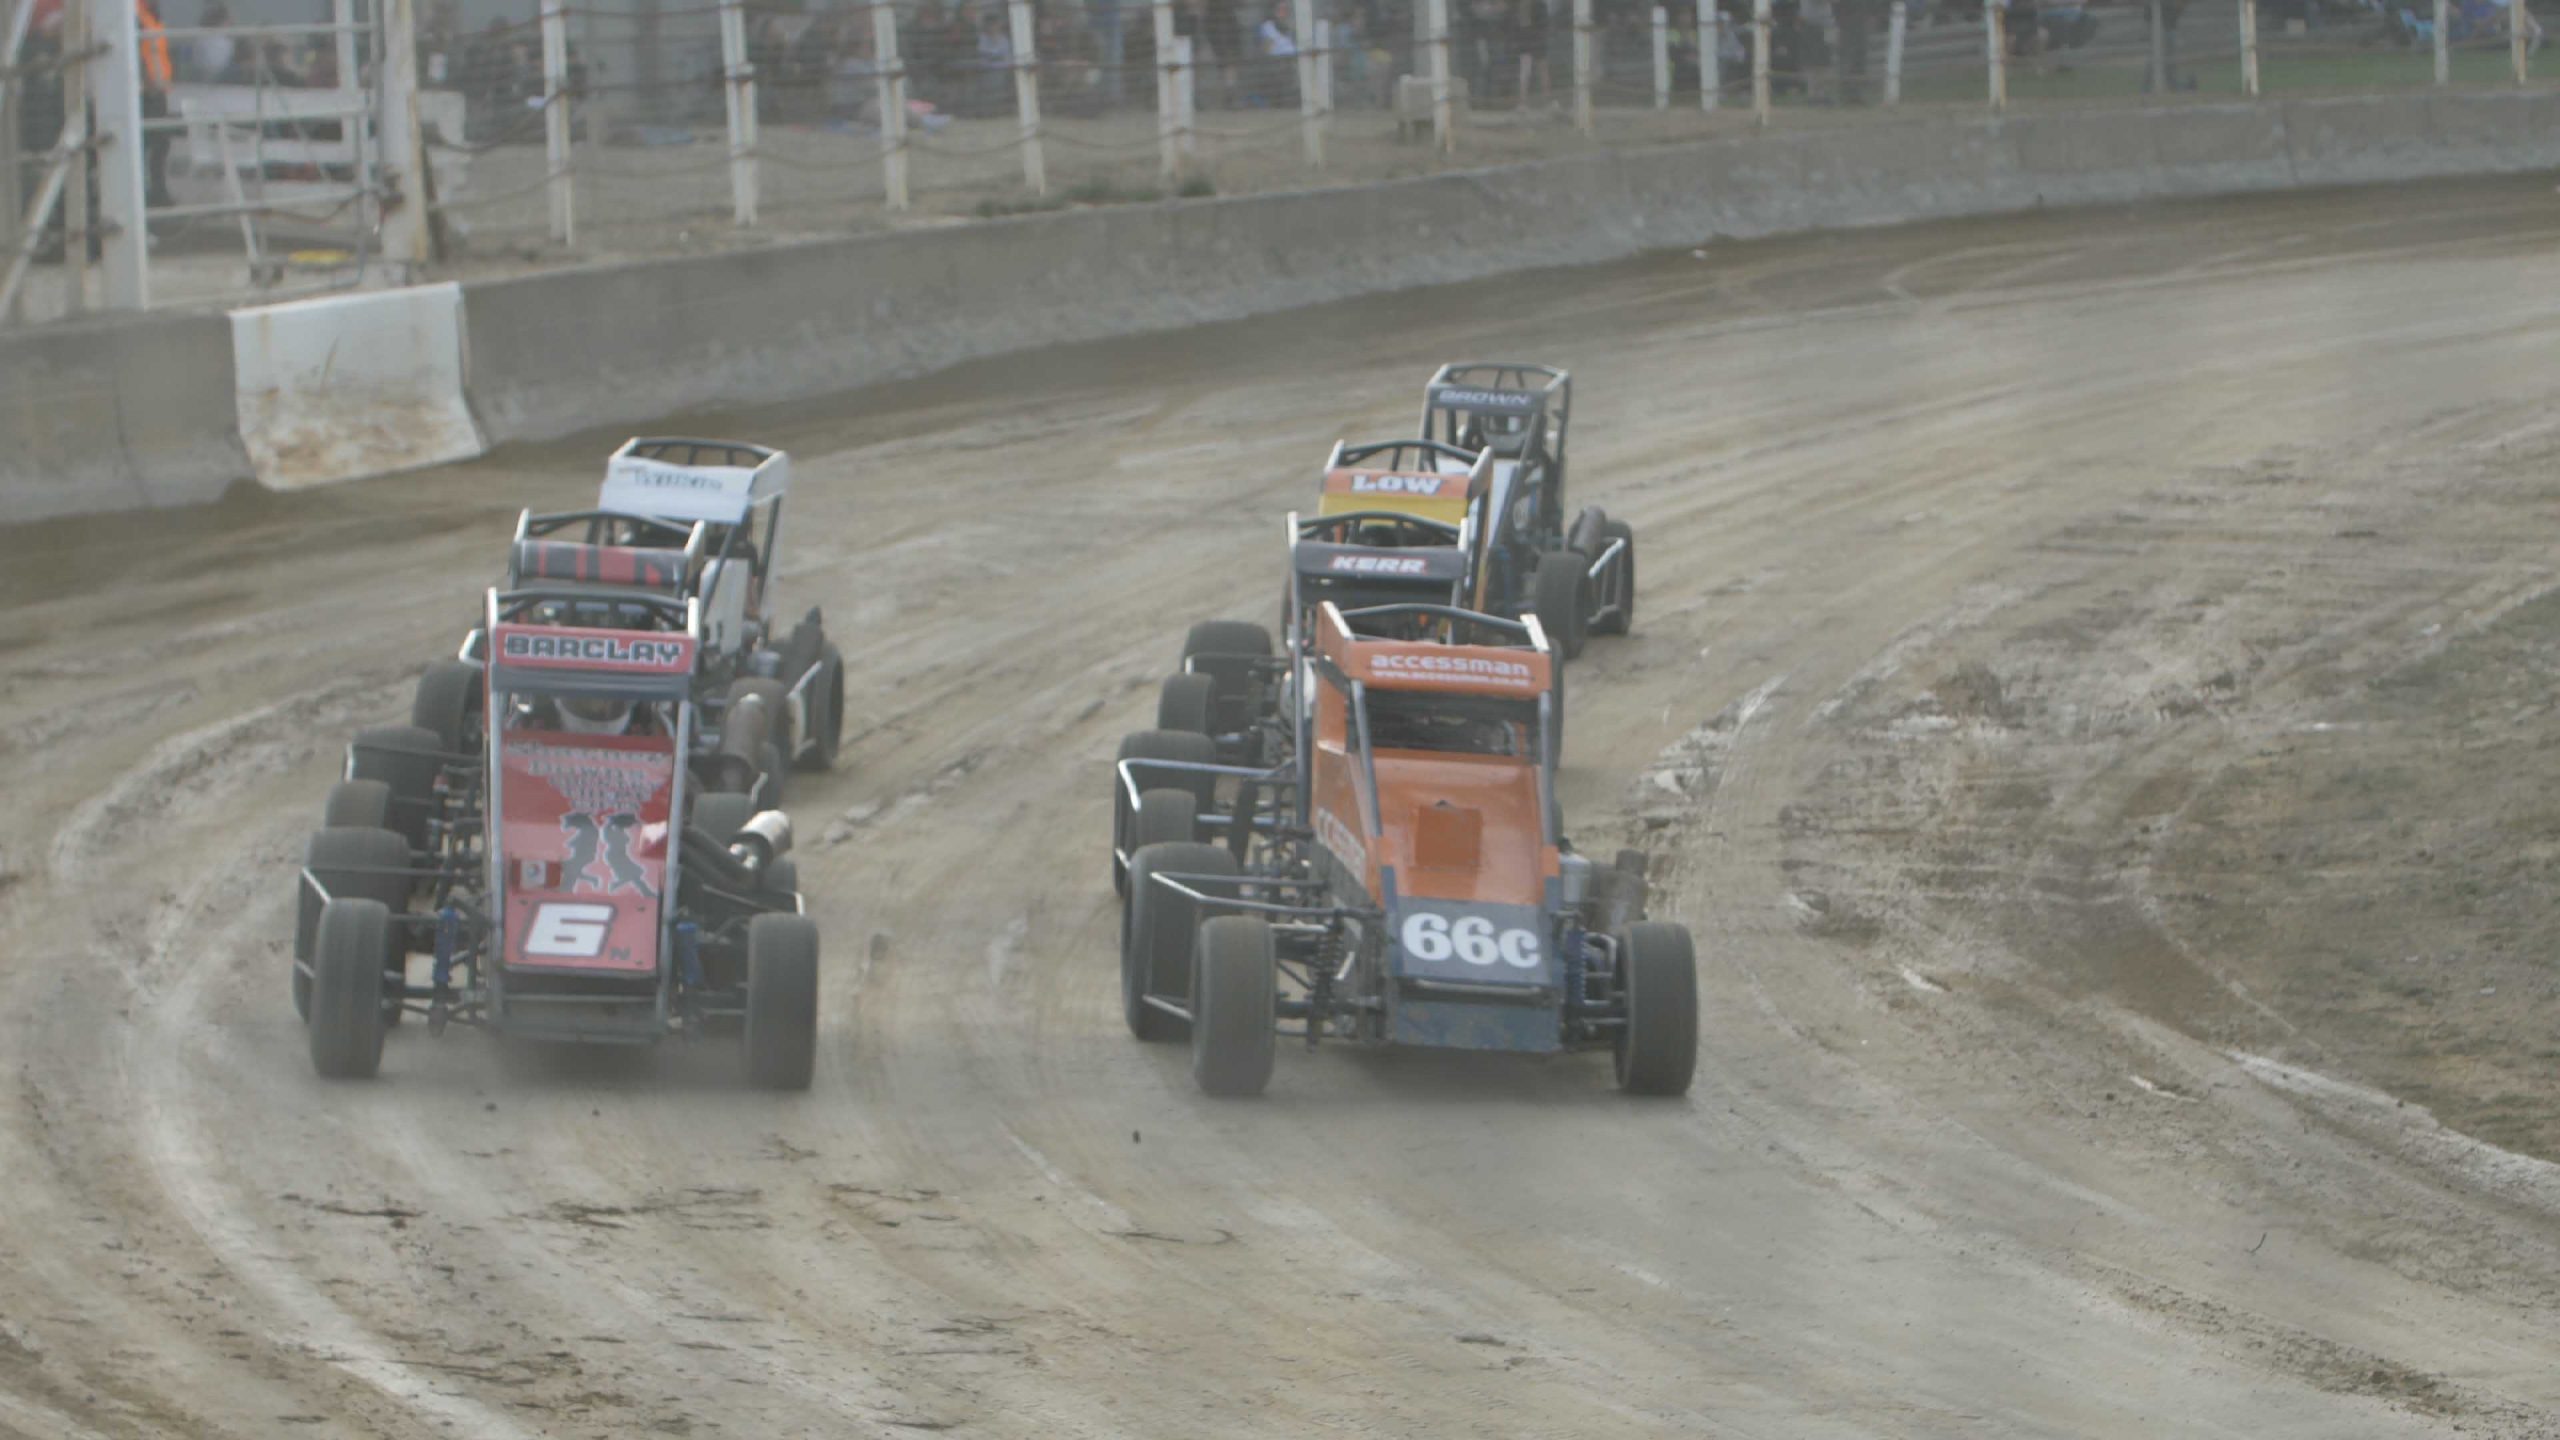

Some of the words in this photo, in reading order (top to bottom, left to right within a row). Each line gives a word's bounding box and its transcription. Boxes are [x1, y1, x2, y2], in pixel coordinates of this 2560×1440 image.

[1438, 389, 1530, 406] BROWN
[1352, 474, 1442, 495] LOW
[1331, 554, 1427, 574] KERR
[504, 633, 682, 665] BARCLAY
[1370, 653, 1530, 677] accessman
[521, 901, 616, 957] 6
